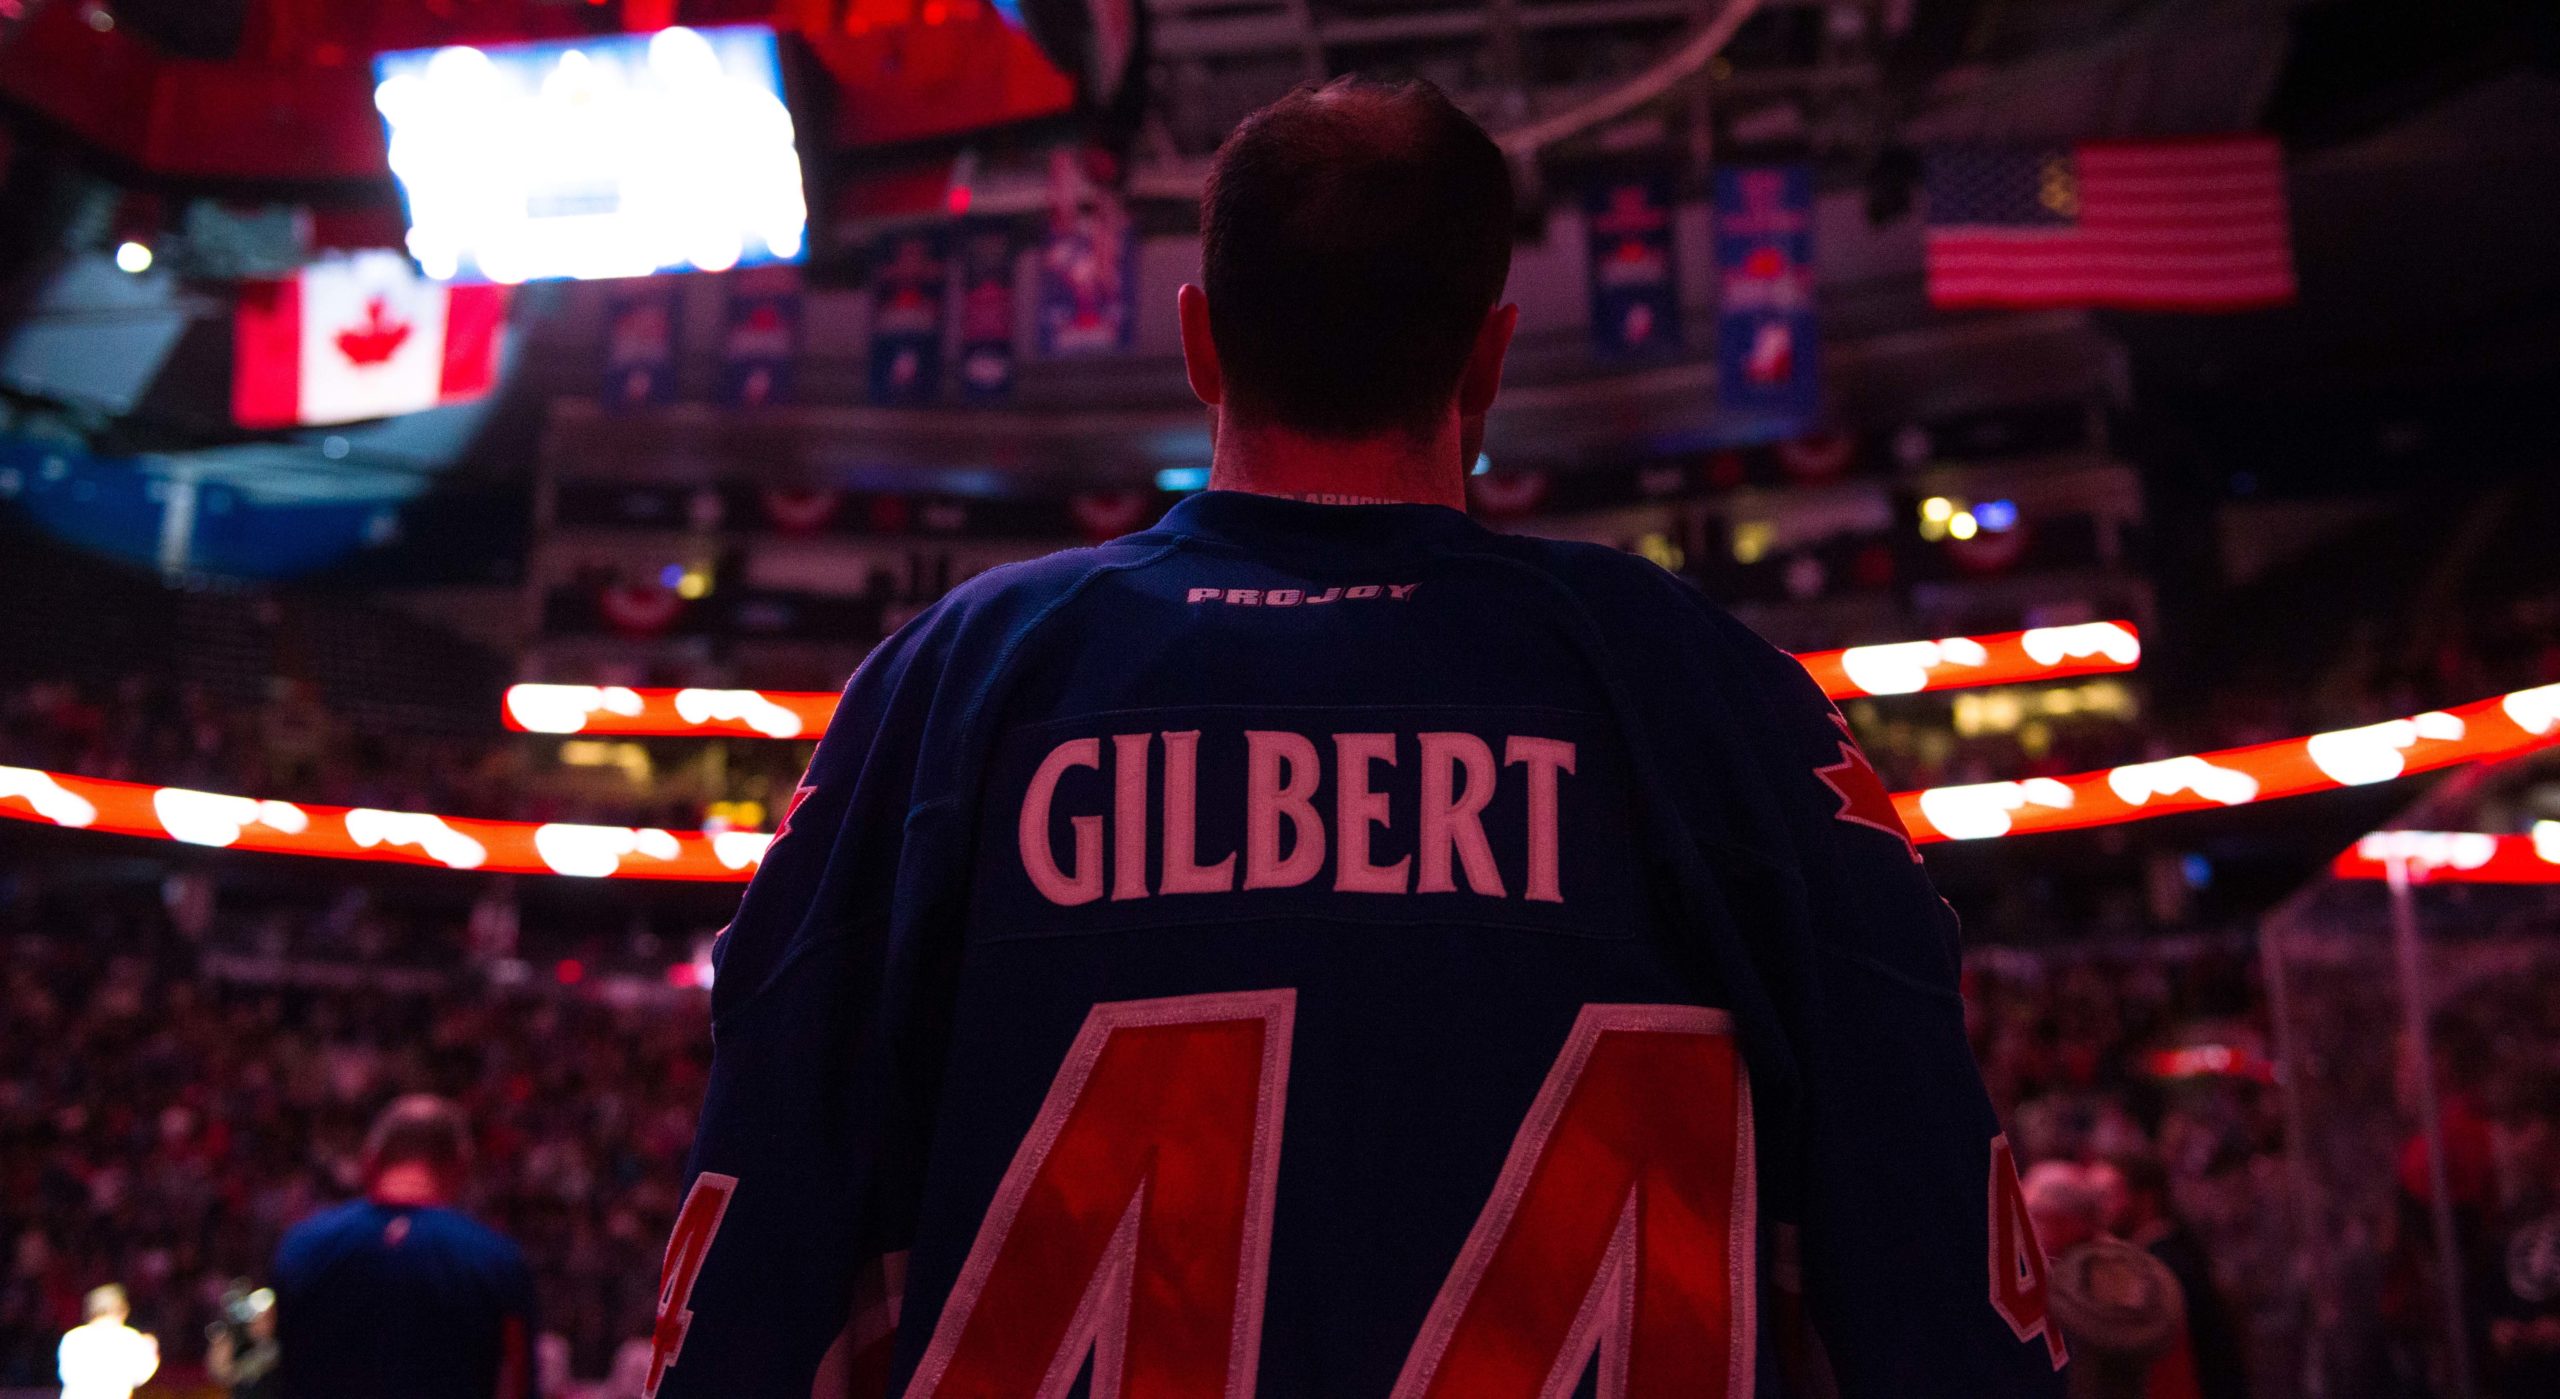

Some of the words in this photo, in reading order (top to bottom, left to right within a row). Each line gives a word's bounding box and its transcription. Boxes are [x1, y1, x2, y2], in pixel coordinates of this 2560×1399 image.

[1186, 582, 1423, 607] PROJOY
[1018, 729, 1576, 906] GILBERT
[903, 988, 1757, 1399] 44
